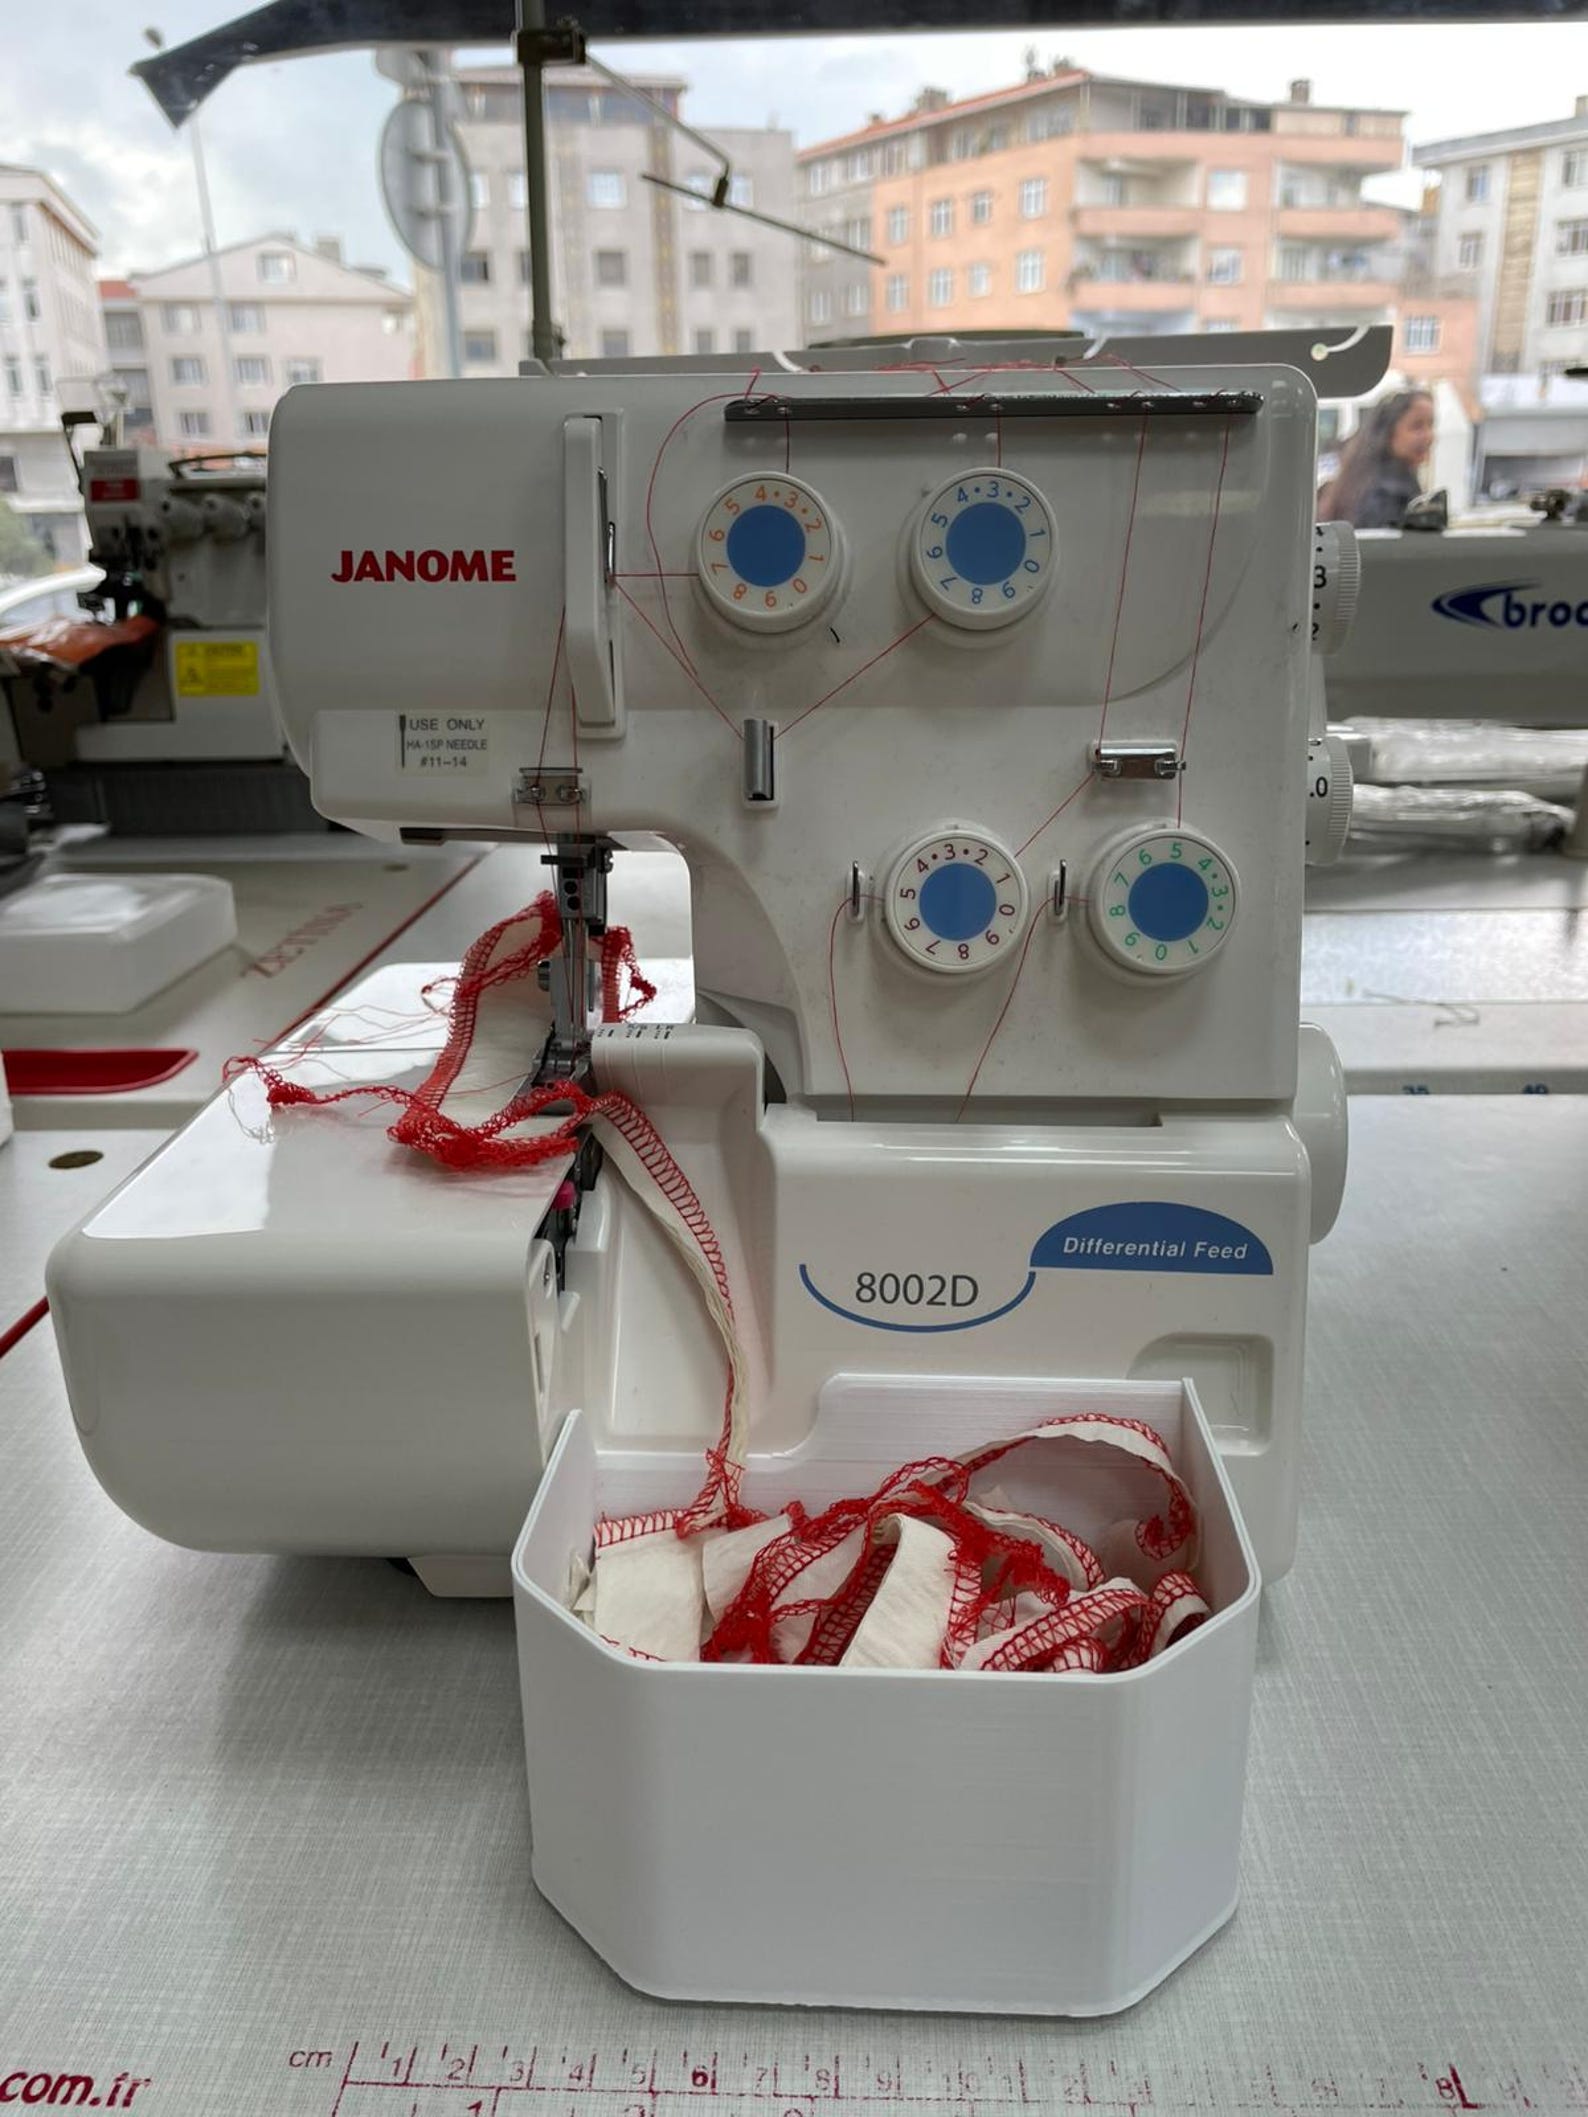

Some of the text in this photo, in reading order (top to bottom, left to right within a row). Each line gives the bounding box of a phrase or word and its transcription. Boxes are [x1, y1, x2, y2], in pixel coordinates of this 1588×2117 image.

[755, 485, 767, 501] 4
[957, 487, 968, 502] 4
[987, 481, 999, 498] 3
[724, 498, 740, 515] 5
[784, 491, 798, 508] 3
[1014, 496, 1030, 513] 2
[805, 518, 822, 533] 2
[931, 513, 947, 527] 5
[709, 530, 725, 541] 6
[926, 546, 943, 559] 6
[331, 550, 516, 582] JANOME
[711, 563, 728, 574] 7
[1024, 560, 1039, 573] 0
[733, 583, 747, 599] 8
[792, 578, 807, 593] 0
[940, 577, 957, 591] 7
[972, 588, 983, 604] 8
[409, 718, 485, 731] USE ONLY
[446, 739, 487, 750] NEEDLE
[421, 756, 467, 768] #11-14
[944, 844, 955, 860] 3
[975, 849, 988, 865] 2
[1139, 849, 1152, 865] 6
[1170, 843, 1182, 859] 5
[917, 859, 929, 872] 4
[1199, 858, 1212, 870] 4
[997, 873, 1010, 883] 1
[1114, 872, 1129, 886] 7
[900, 889, 915, 899] 5
[1212, 886, 1228, 897] 3
[999, 904, 1015, 915] 0
[1109, 905, 1126, 916] 8
[904, 918, 920, 930] 6
[1206, 917, 1224, 930] 2
[925, 941, 940, 955] 7
[958, 944, 969, 960] 8
[1156, 944, 1167, 960] 0
[1188, 941, 1198, 954] 1
[1063, 1237, 1248, 1260] Differential Feed
[856, 1272, 979, 1307] 8002D
[289, 2051, 332, 2068] cm
[392, 2056, 403, 2077] 1
[447, 2058, 466, 2080] 2
[509, 2061, 524, 2081] 3
[569, 2064, 583, 2082] 4
[630, 2063, 647, 2085] 5
[691, 2065, 709, 2087] 6
